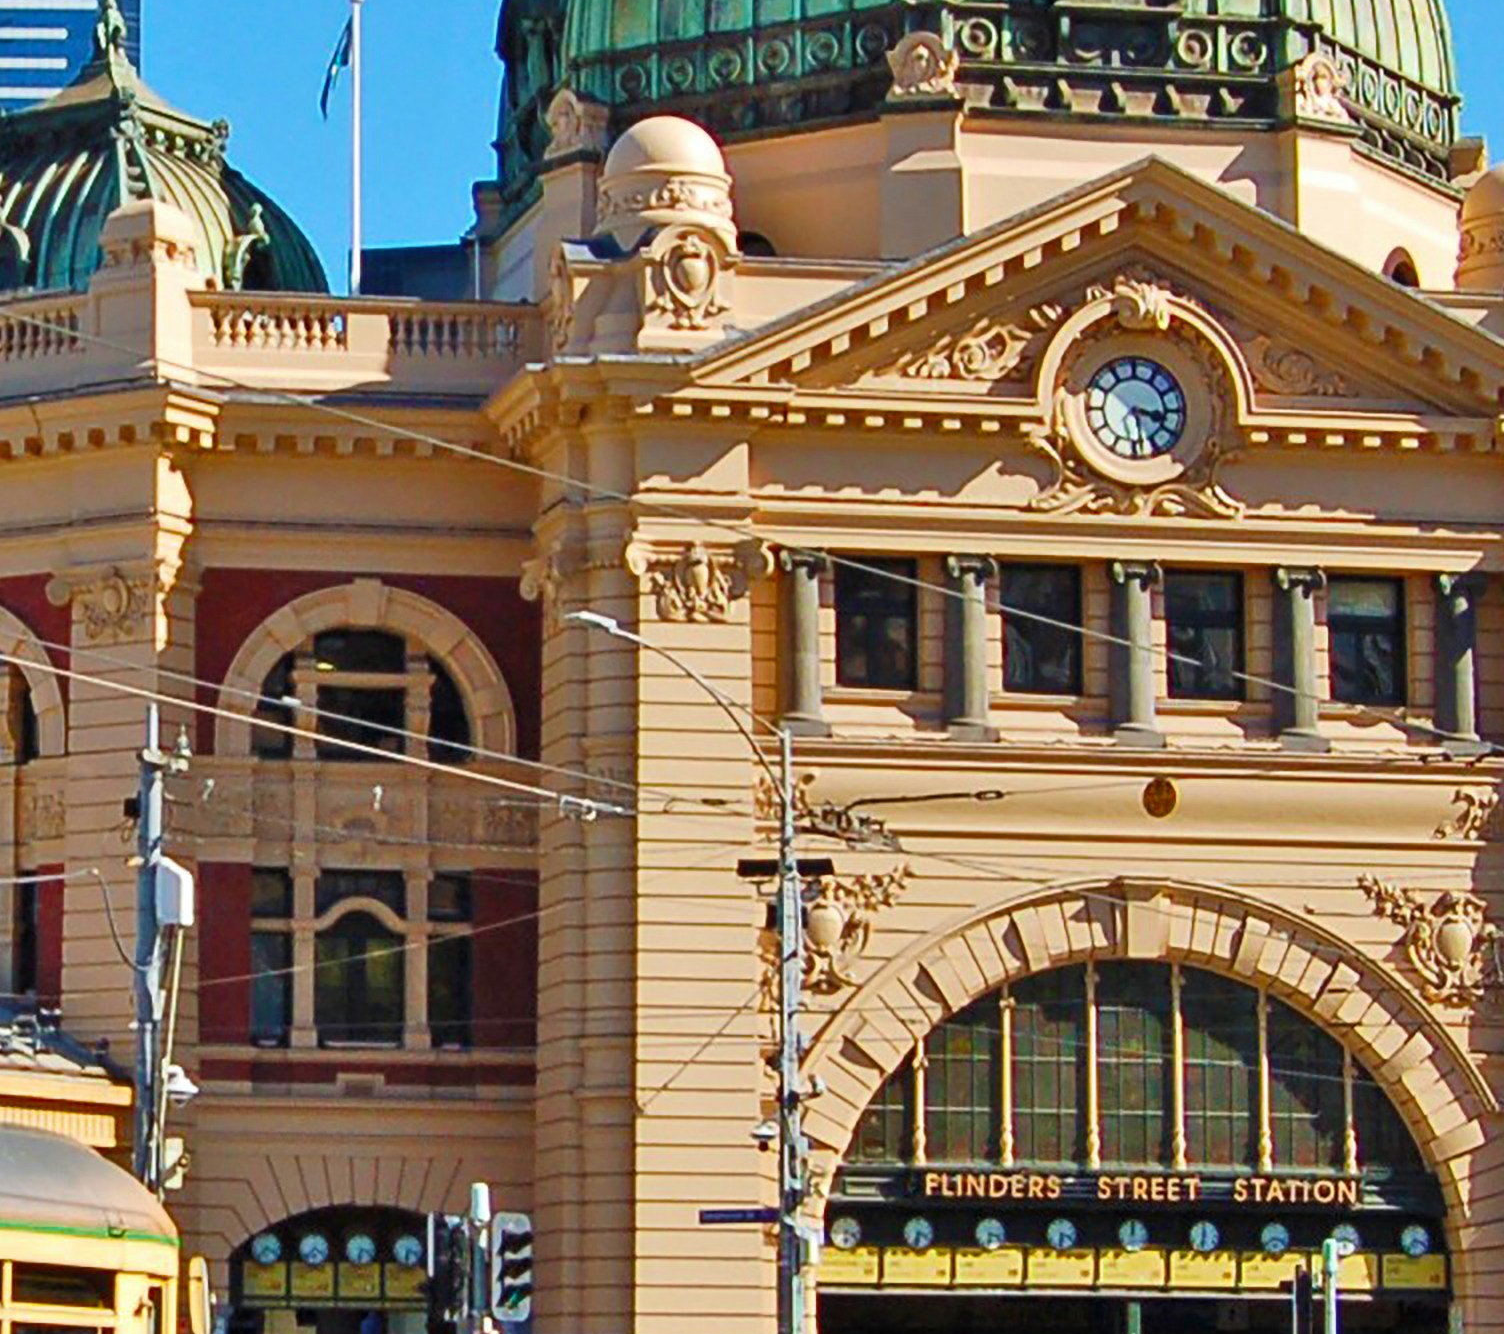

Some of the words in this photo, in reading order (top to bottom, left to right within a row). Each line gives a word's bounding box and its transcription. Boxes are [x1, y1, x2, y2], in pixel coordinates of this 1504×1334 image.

[924, 1173, 1063, 1198] FLINDERS
[1097, 1176, 1200, 1201] STREET
[1233, 1179, 1357, 1204] STATION
